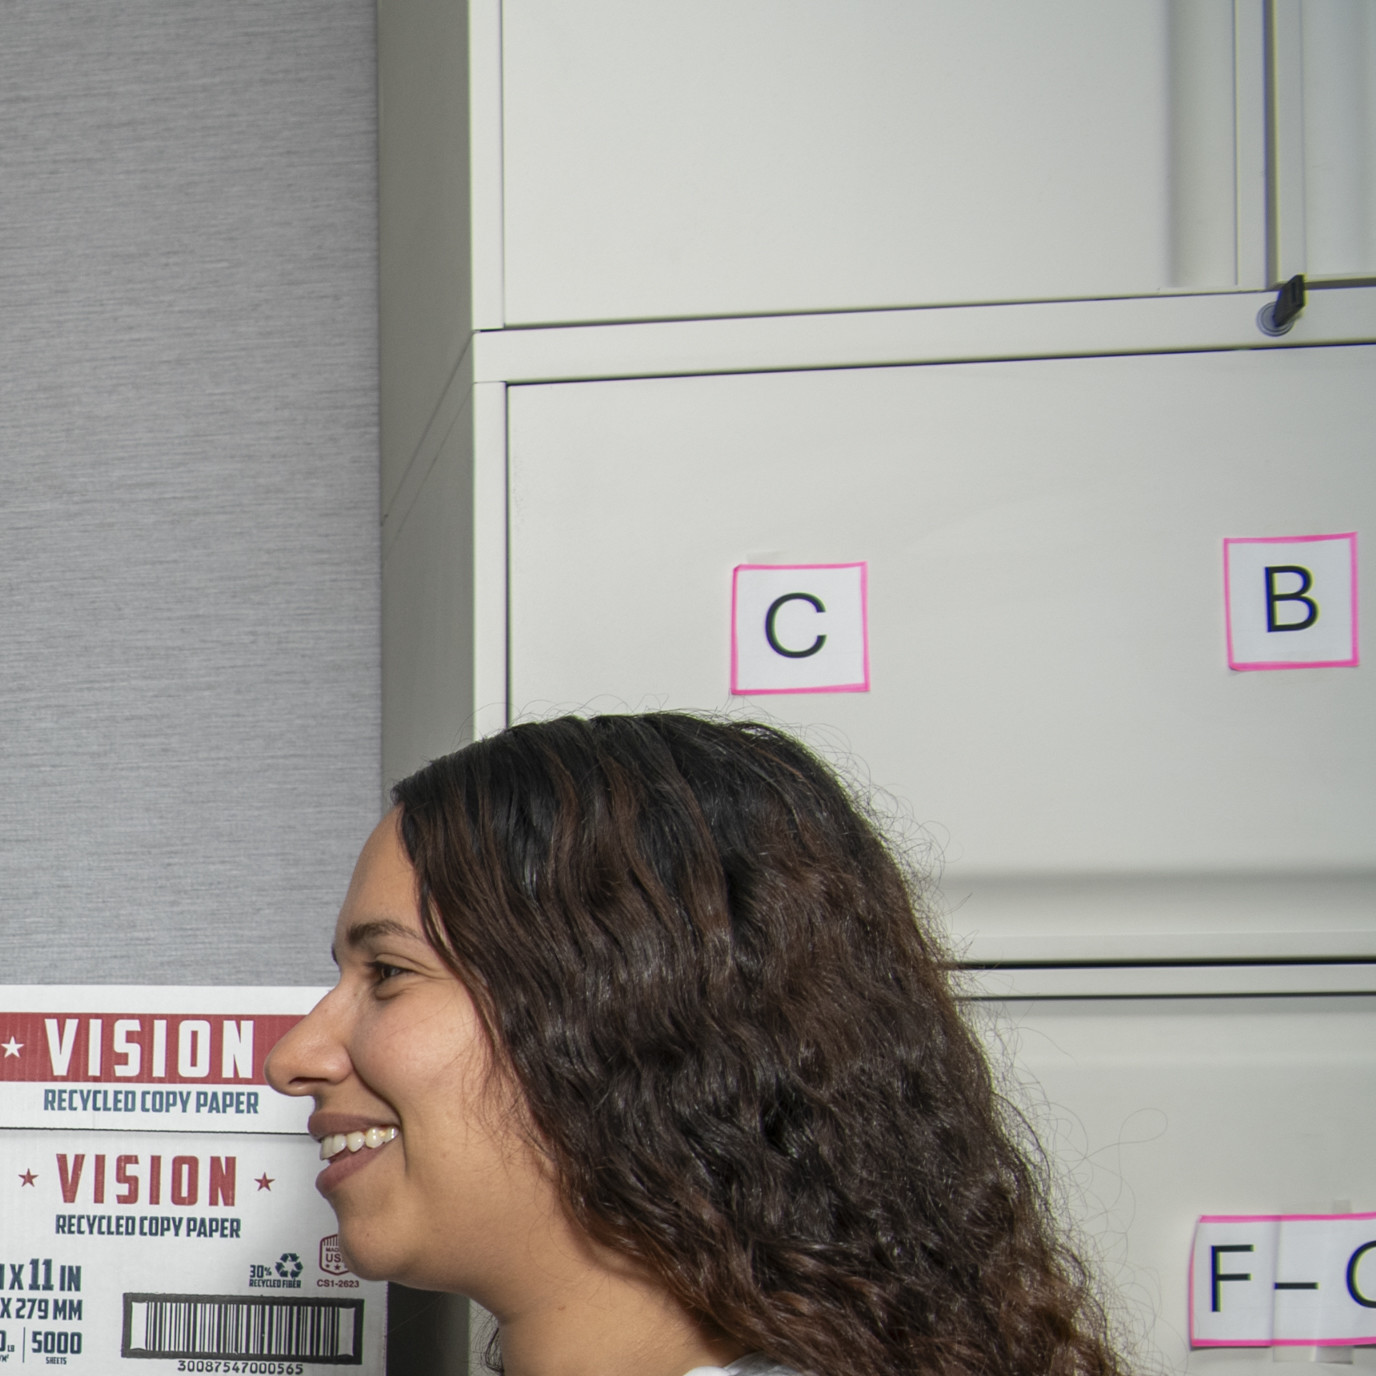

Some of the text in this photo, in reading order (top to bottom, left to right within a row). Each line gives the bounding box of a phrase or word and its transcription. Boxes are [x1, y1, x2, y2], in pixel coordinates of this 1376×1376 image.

[1265, 565, 1319, 633] B
[764, 592, 827, 658] C
[45, 1018, 254, 1079] VISION
[43, 1088, 259, 1115] RECYCLED COPY PAPER
[56, 1153, 236, 1207] VISION
[55, 1214, 241, 1239] RECYCLED COPY PAPER
[325, 1253, 342, 1263] US
[8, 1264, 24, 1291] X
[28, 1259, 54, 1291] 11
[59, 1265, 82, 1292] IN
[250, 1264, 272, 1278] 30%
[249, 1278, 302, 1288] RECYCLED FIBER
[316, 1279, 360, 1288] CS1-2623
[0, 1298, 14, 1319] X
[15, 1299, 49, 1320] 279
[52, 1300, 83, 1321] MM
[31, 1331, 82, 1354] 5000
[45, 1356, 67, 1365] SHEETS
[177, 1360, 304, 1376] 30087547000565
